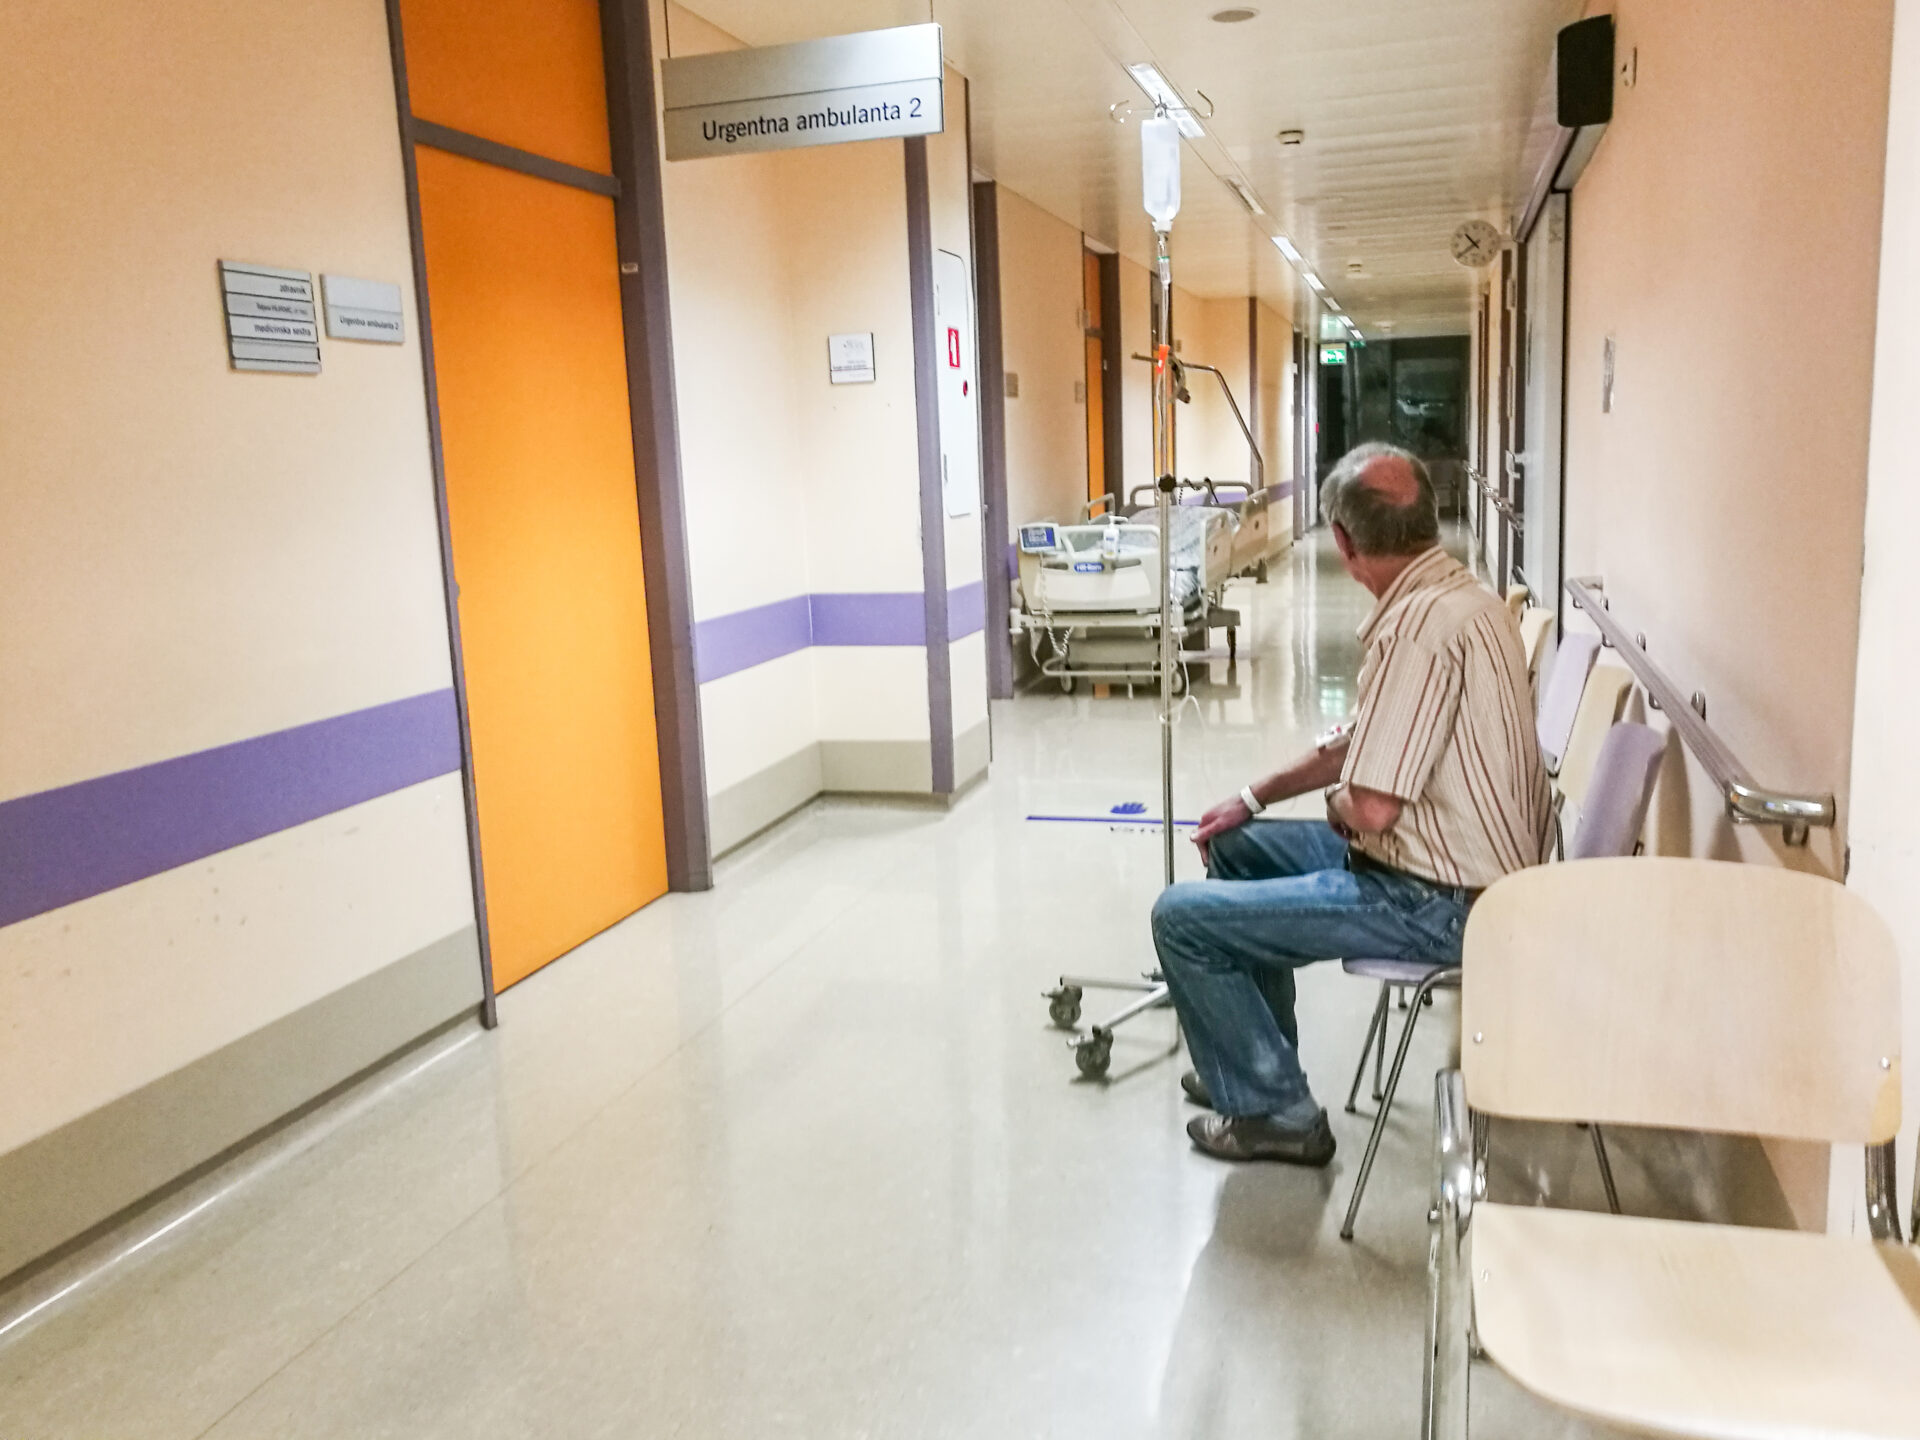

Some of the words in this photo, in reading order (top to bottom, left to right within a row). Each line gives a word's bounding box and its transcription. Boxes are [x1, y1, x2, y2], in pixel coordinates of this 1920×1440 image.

[702, 115, 789, 143] Urgentna
[796, 102, 901, 131] ambulanta
[909, 97, 922, 118] 2
[339, 315, 366, 327] Urgentna
[367, 319, 394, 330] ambulanta
